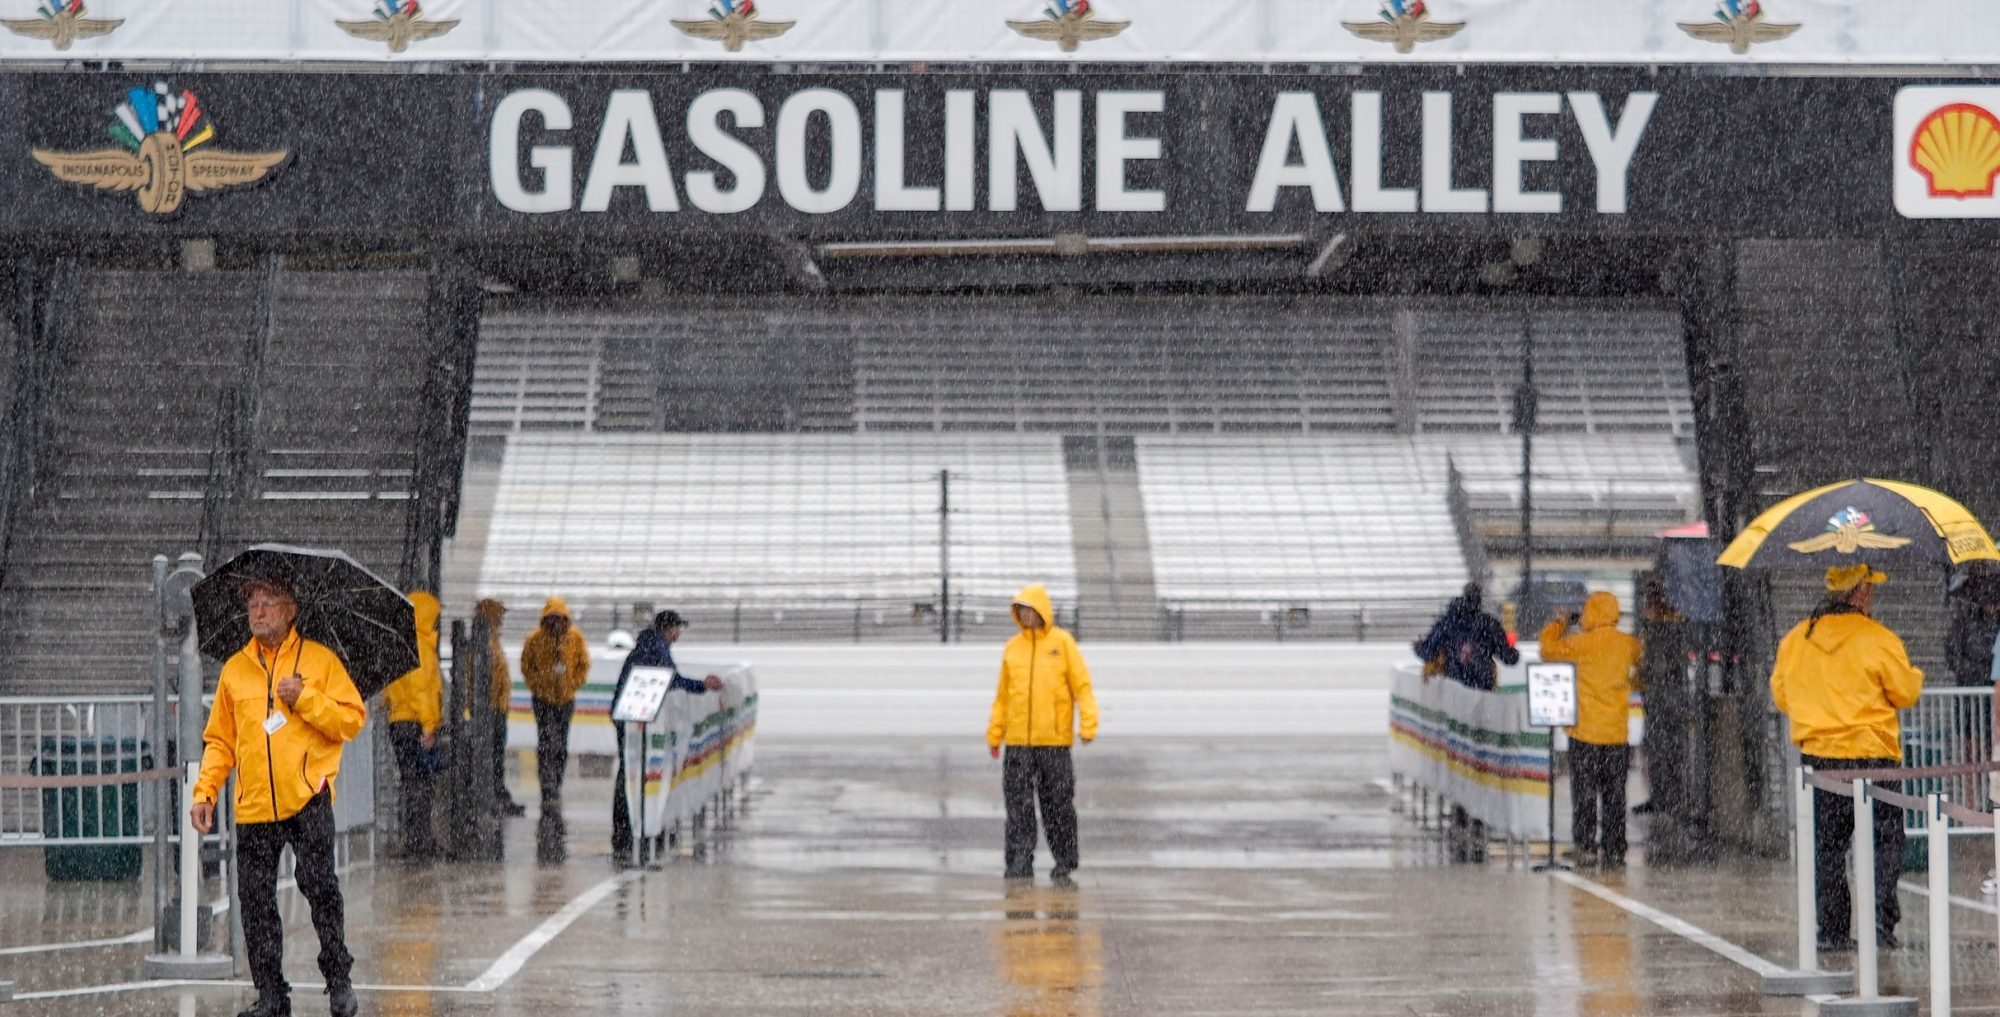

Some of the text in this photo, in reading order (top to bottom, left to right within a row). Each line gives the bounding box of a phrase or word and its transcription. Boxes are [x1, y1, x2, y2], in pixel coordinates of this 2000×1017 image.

[491, 89, 1659, 213] GASOLINE ALLEY
[62, 164, 145, 178] INDIANAPOLIS
[164, 143, 178, 206] MOTOR
[191, 164, 256, 179] SPEEDWAY
